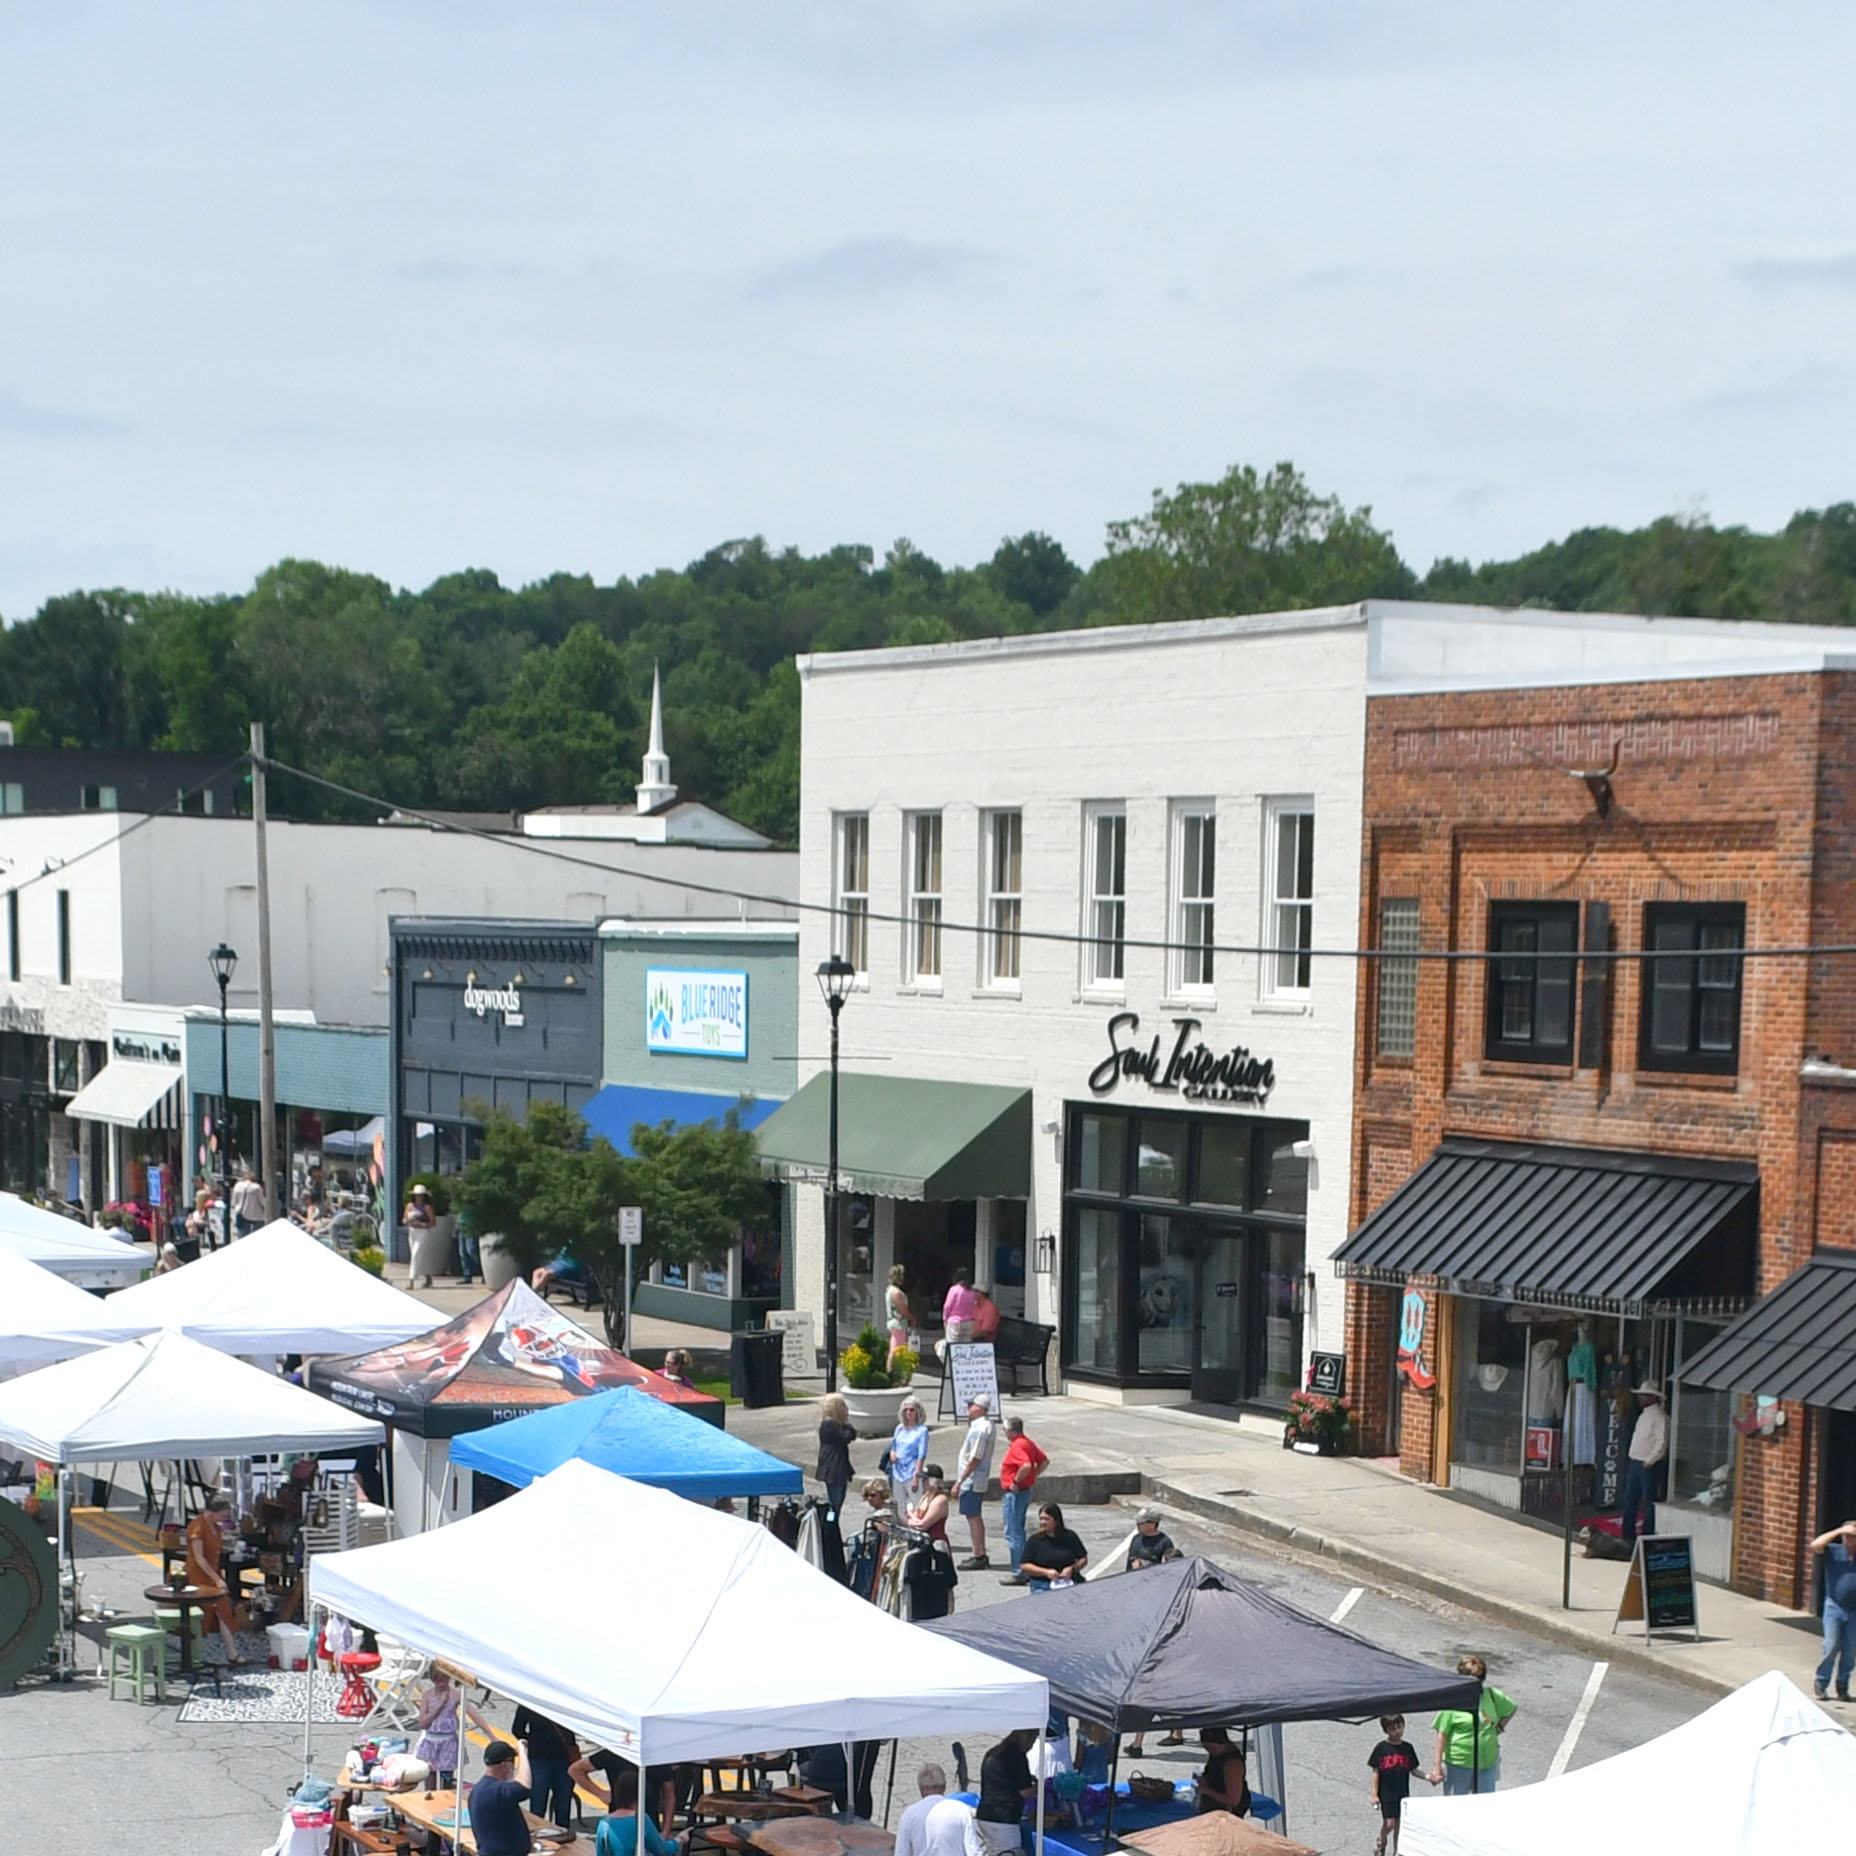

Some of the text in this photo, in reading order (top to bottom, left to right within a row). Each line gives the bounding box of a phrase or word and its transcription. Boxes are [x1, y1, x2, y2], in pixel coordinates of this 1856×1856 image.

[464, 980, 520, 1016] dogwoods
[681, 984, 742, 1028] BLUE RIDGE
[702, 1023, 721, 1046] TOYS
[1088, 1013, 1274, 1091] Soul Intention
[1183, 1086, 1268, 1104] GALLERY
[493, 1409, 539, 1421] MOUN
